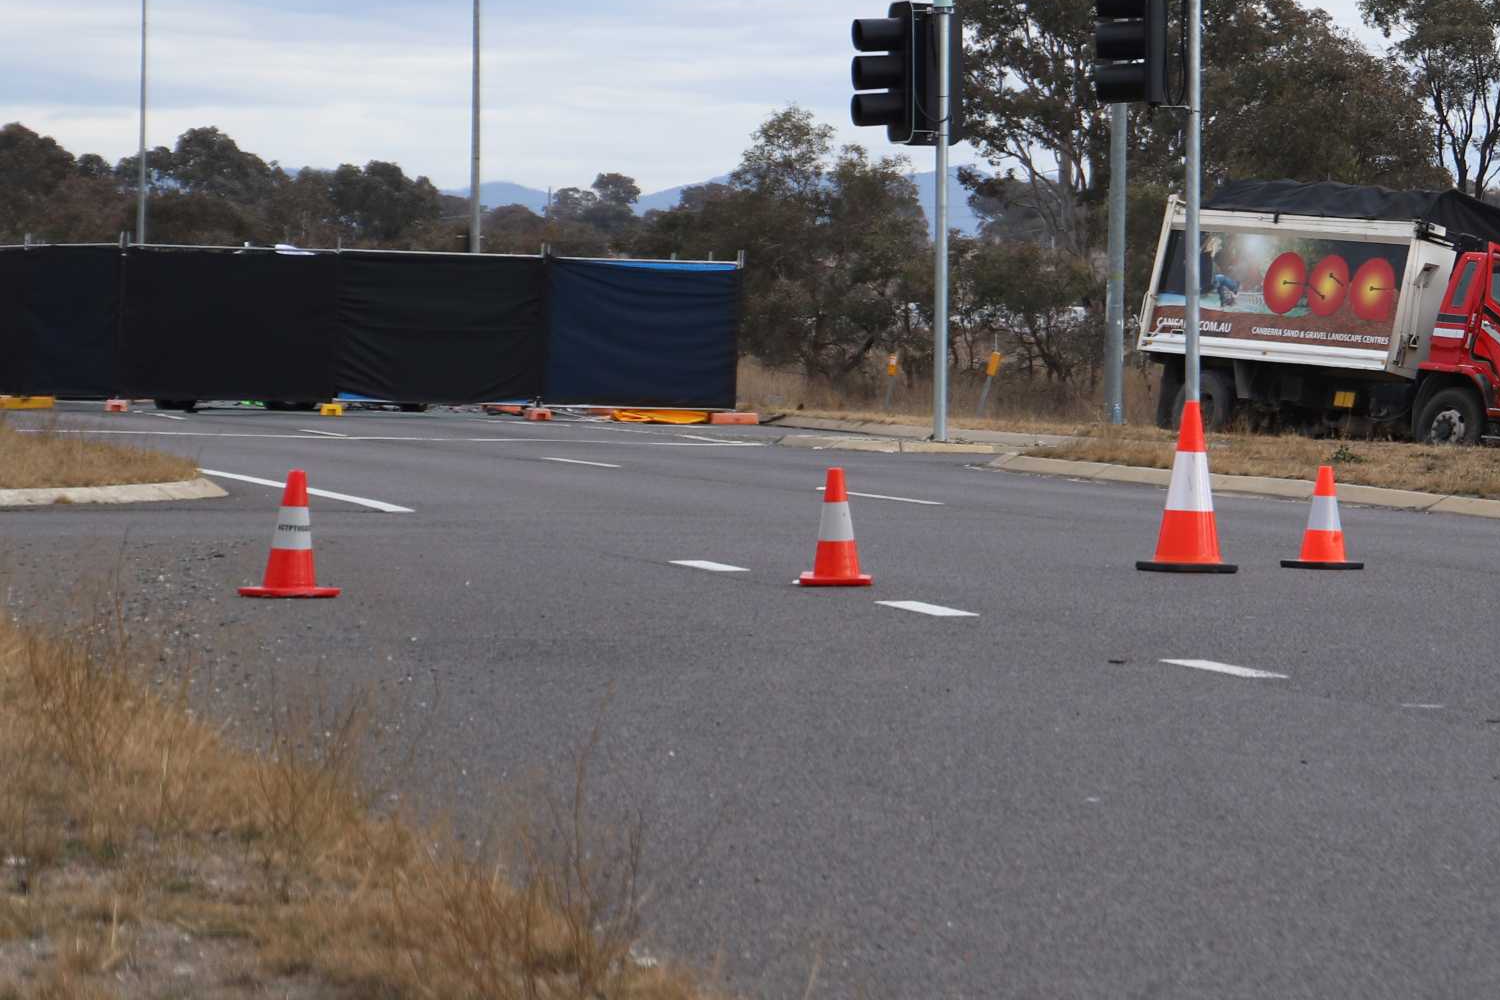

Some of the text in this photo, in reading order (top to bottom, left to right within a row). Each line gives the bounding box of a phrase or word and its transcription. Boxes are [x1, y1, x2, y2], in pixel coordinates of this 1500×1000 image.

[1251, 326, 1282, 336] CANBERRA
[1283, 328, 1299, 337] SAND
[1305, 331, 1327, 339] GRAVEL
[1328, 332, 1361, 342] LANDSCAPE
[1362, 335, 1389, 345] CENTRES
